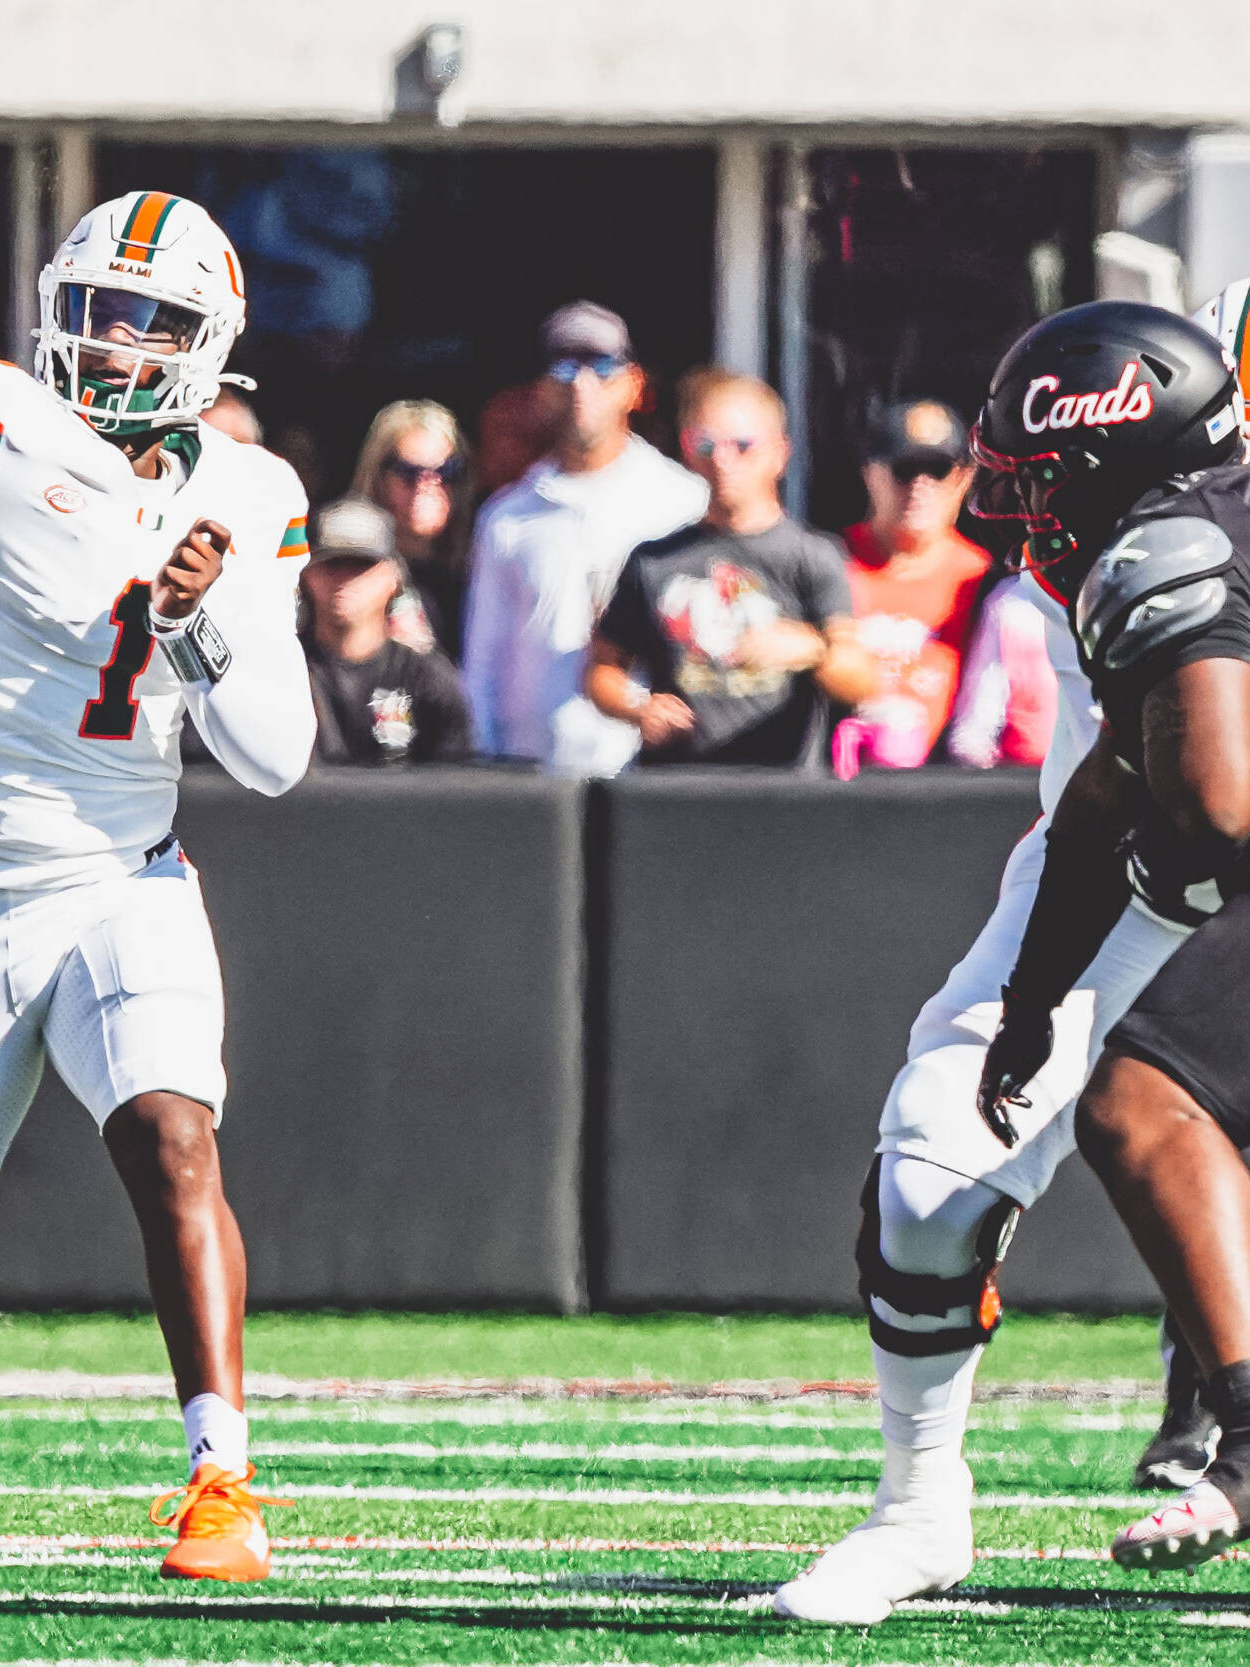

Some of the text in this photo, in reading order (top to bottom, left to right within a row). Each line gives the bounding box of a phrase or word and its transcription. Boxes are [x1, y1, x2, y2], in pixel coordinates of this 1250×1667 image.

[109, 261, 152, 278] MIAMI
[1023, 361, 1154, 434] Cards
[78, 578, 156, 740] 1
